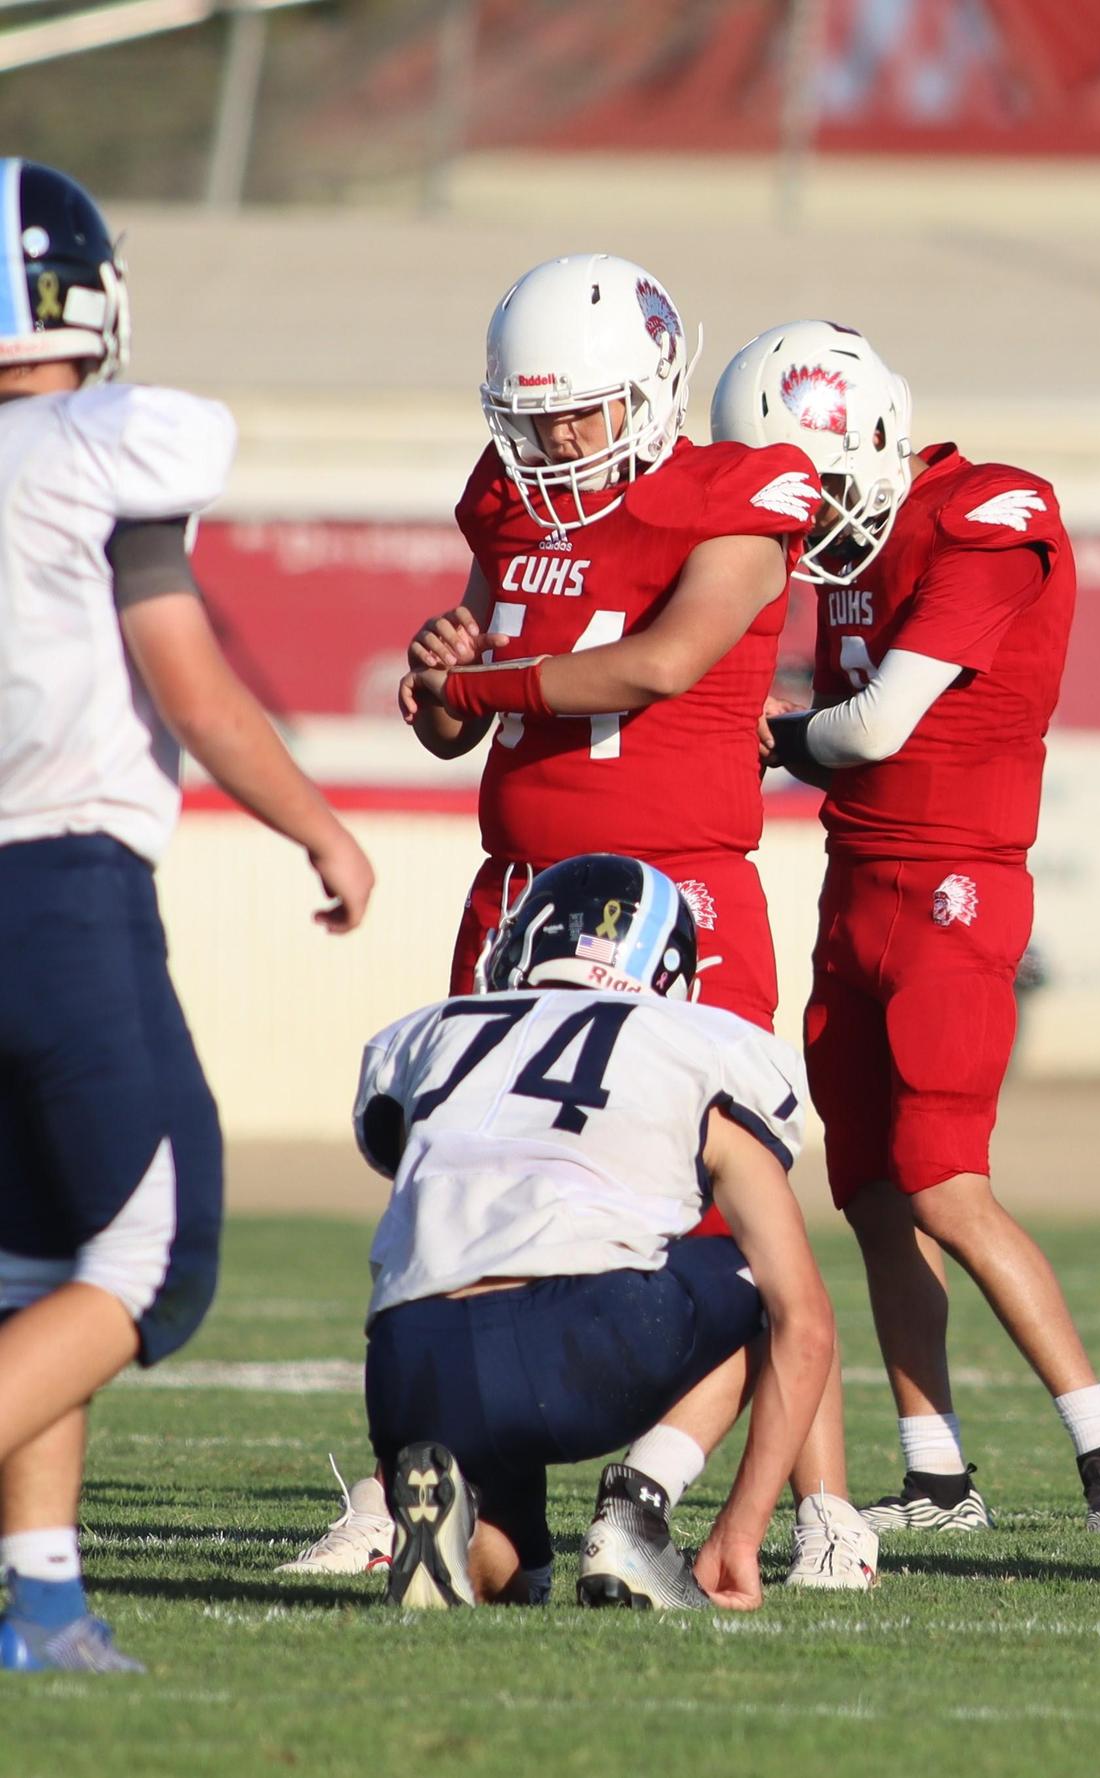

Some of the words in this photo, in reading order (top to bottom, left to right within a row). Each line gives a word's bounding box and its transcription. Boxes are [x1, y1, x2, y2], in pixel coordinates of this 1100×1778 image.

[538, 540, 574, 552] adidas
[501, 554, 592, 597] CUHS
[828, 590, 874, 627] CUHS
[411, 997, 639, 1136] 74
